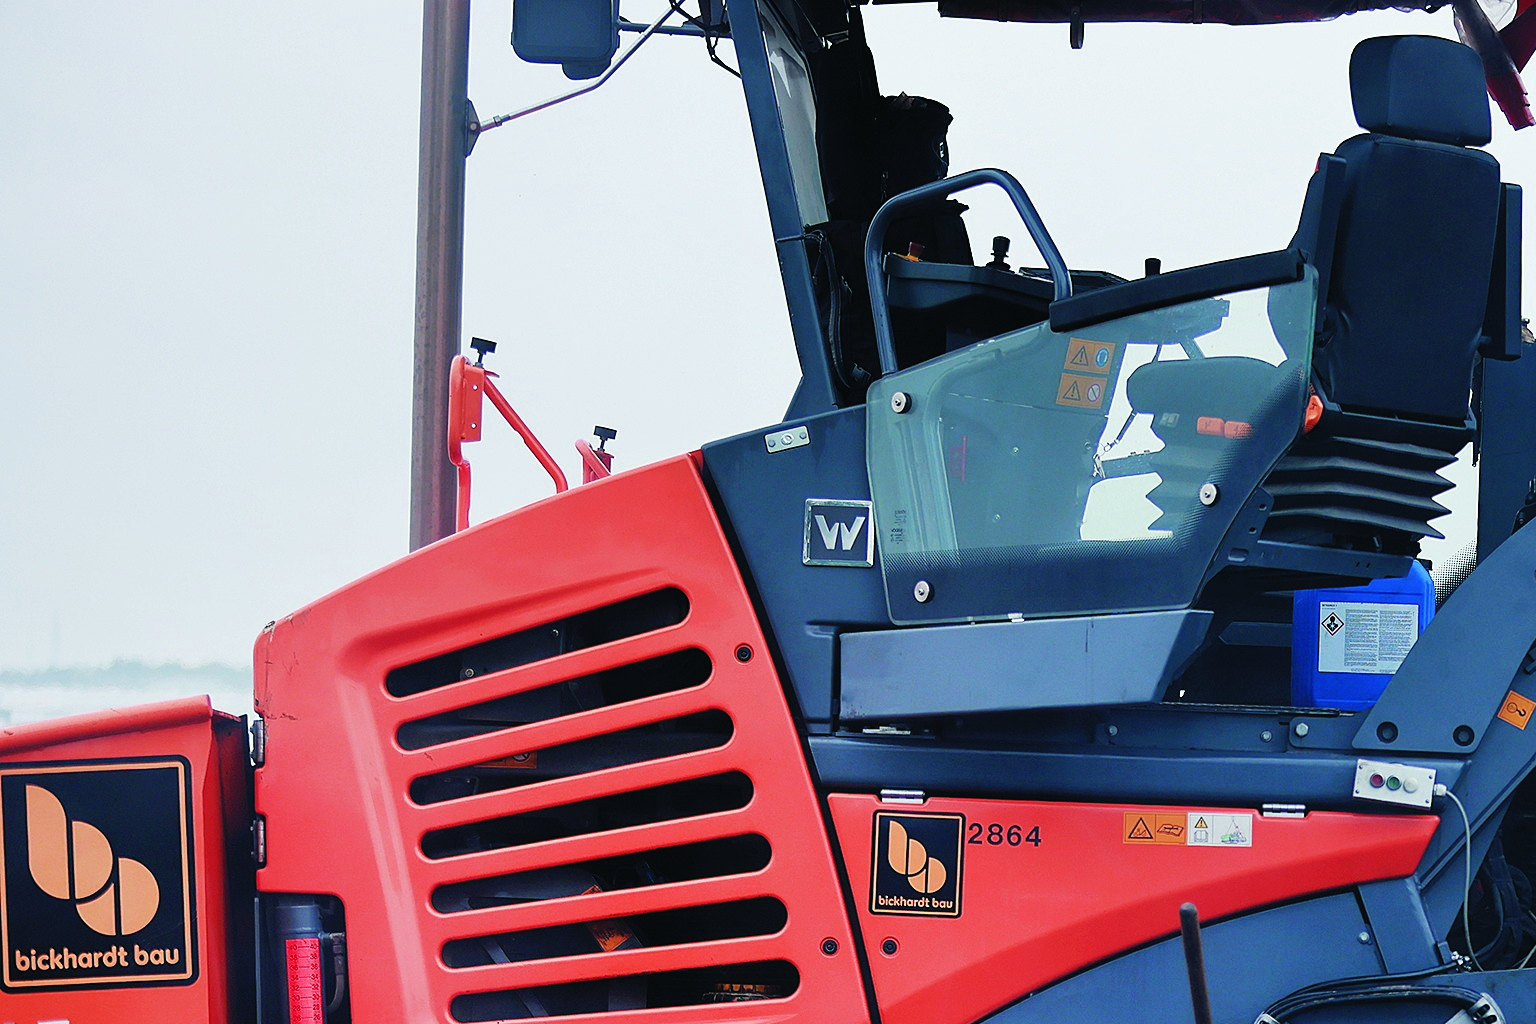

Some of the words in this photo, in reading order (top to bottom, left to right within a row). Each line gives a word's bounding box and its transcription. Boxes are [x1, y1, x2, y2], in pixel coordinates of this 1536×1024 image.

[814, 514, 866, 551] W
[968, 822, 1042, 847] 2864
[878, 894, 930, 908] bickhardt
[932, 897, 953, 909] bau
[15, 945, 129, 972] bickhardt
[134, 944, 179, 966] bau
